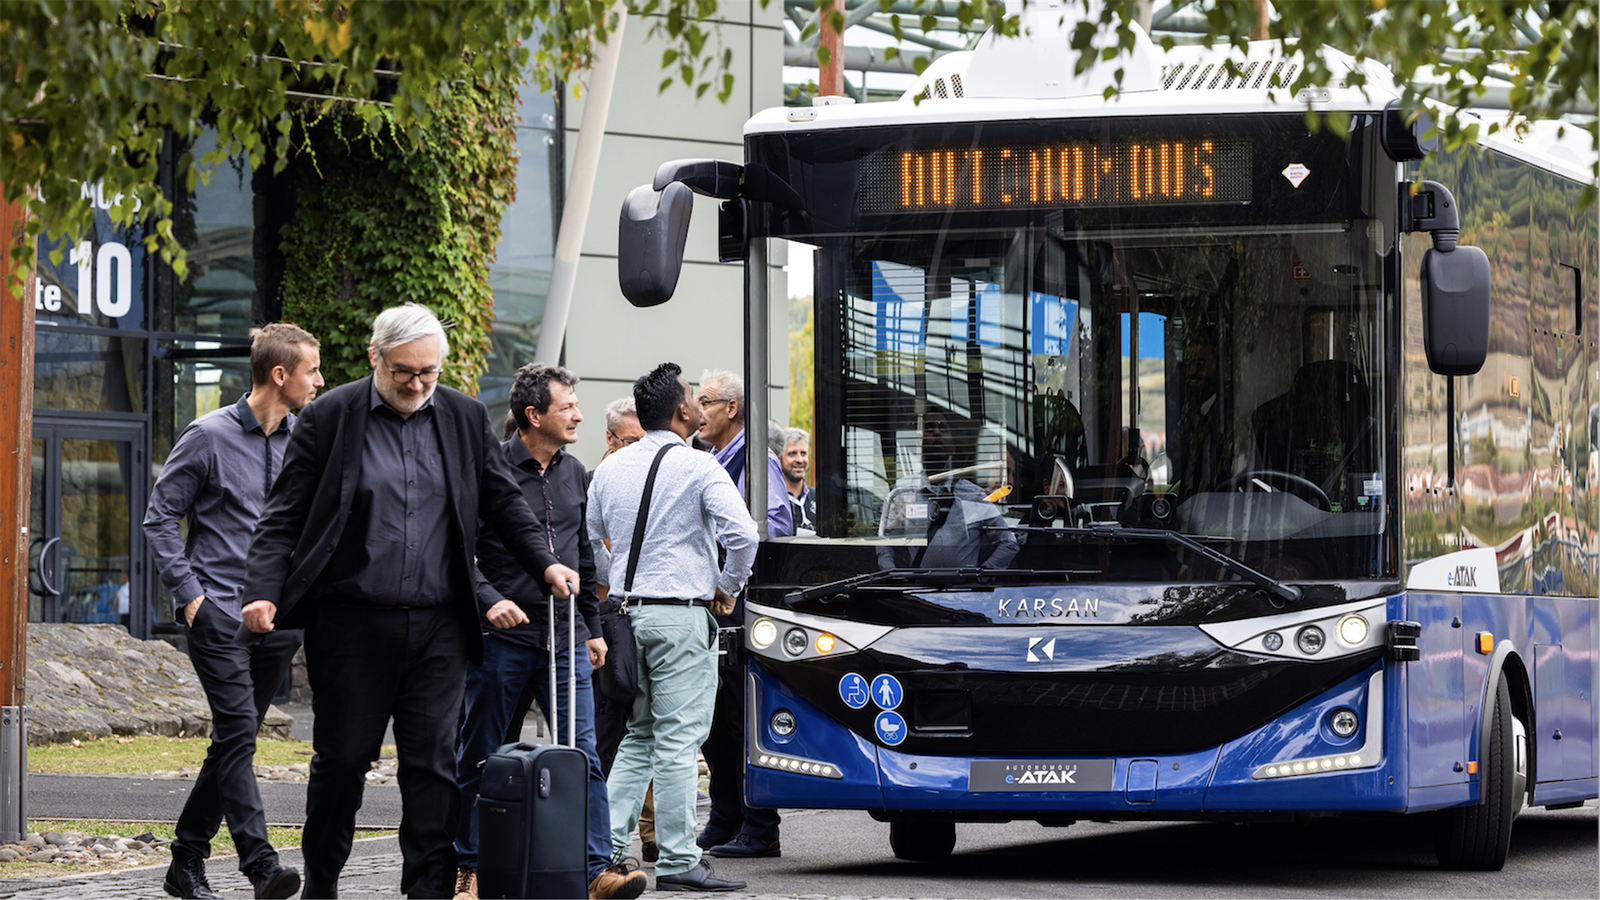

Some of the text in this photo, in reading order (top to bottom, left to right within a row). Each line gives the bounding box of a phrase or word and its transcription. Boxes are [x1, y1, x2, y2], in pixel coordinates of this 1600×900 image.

[901, 141, 1214, 206] AUTONOMOUS
[70, 240, 132, 318] 10
[1447, 565, 1477, 587] e-ATAK
[998, 598, 1099, 618] KARSAN
[1005, 770, 1077, 784] e-ATAK
